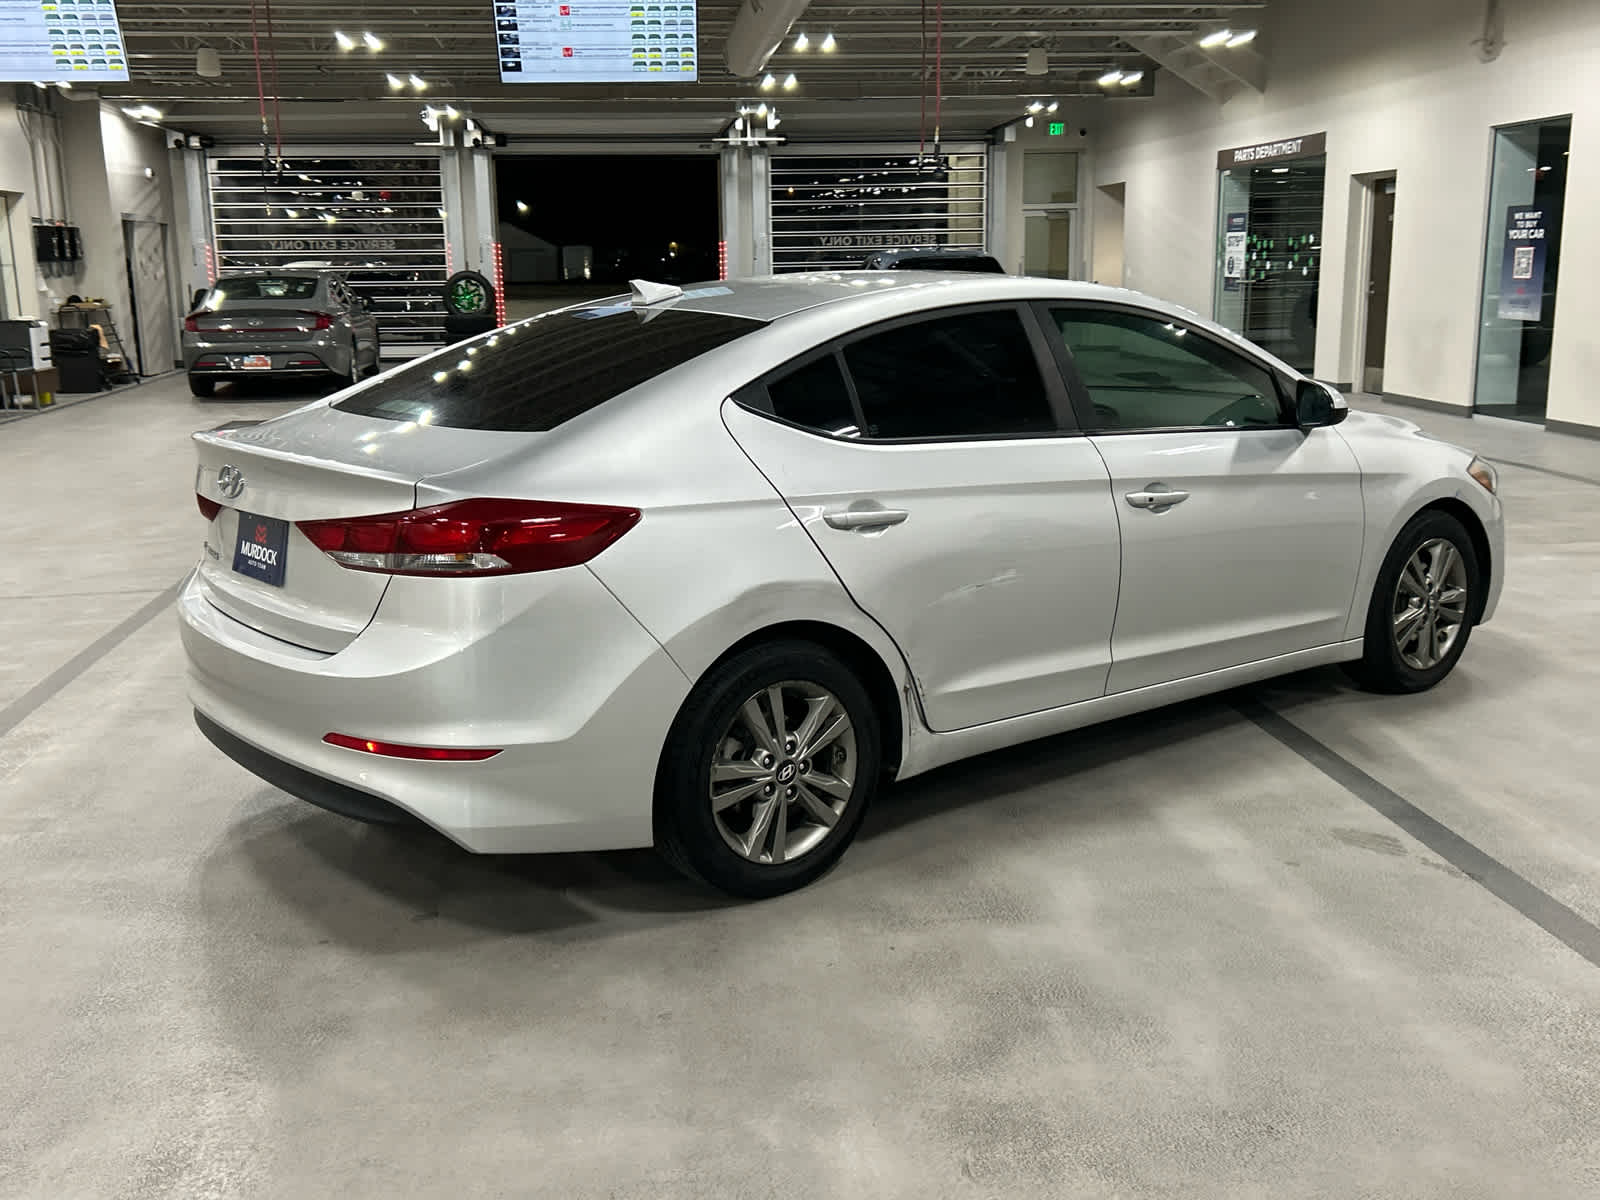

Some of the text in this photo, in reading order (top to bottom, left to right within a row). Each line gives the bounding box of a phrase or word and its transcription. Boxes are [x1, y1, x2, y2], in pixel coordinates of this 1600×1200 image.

[1049, 122, 1065, 136] EXIT
[1234, 139, 1303, 162] PARTS DEPARTMENT
[1509, 229, 1545, 240] YOUR CAR
[240, 540, 278, 566] MURDOCK
